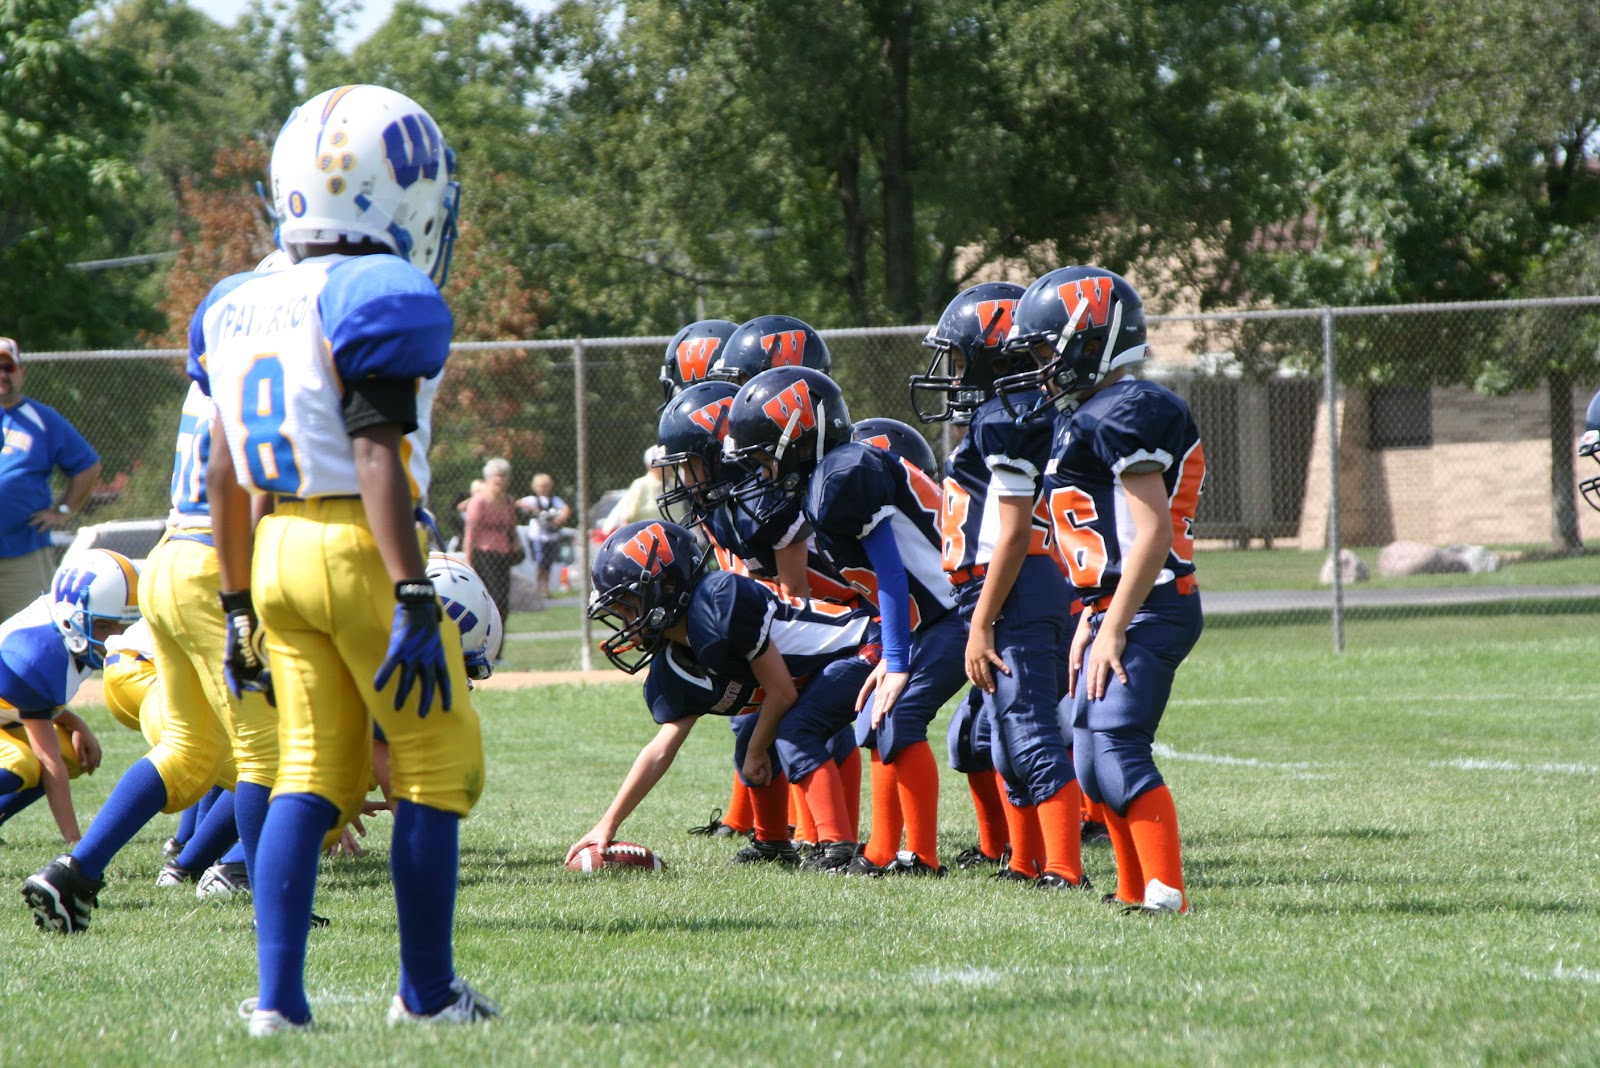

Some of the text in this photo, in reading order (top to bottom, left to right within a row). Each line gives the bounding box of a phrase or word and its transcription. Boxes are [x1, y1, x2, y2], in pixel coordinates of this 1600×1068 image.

[378, 111, 440, 192] W
[975, 298, 1021, 348] W
[1057, 276, 1114, 333] W
[676, 337, 721, 383] W
[760, 331, 807, 368] W
[238, 352, 305, 496] 8
[762, 378, 817, 442] W
[621, 522, 675, 577] W
[1050, 485, 1108, 589] 6
